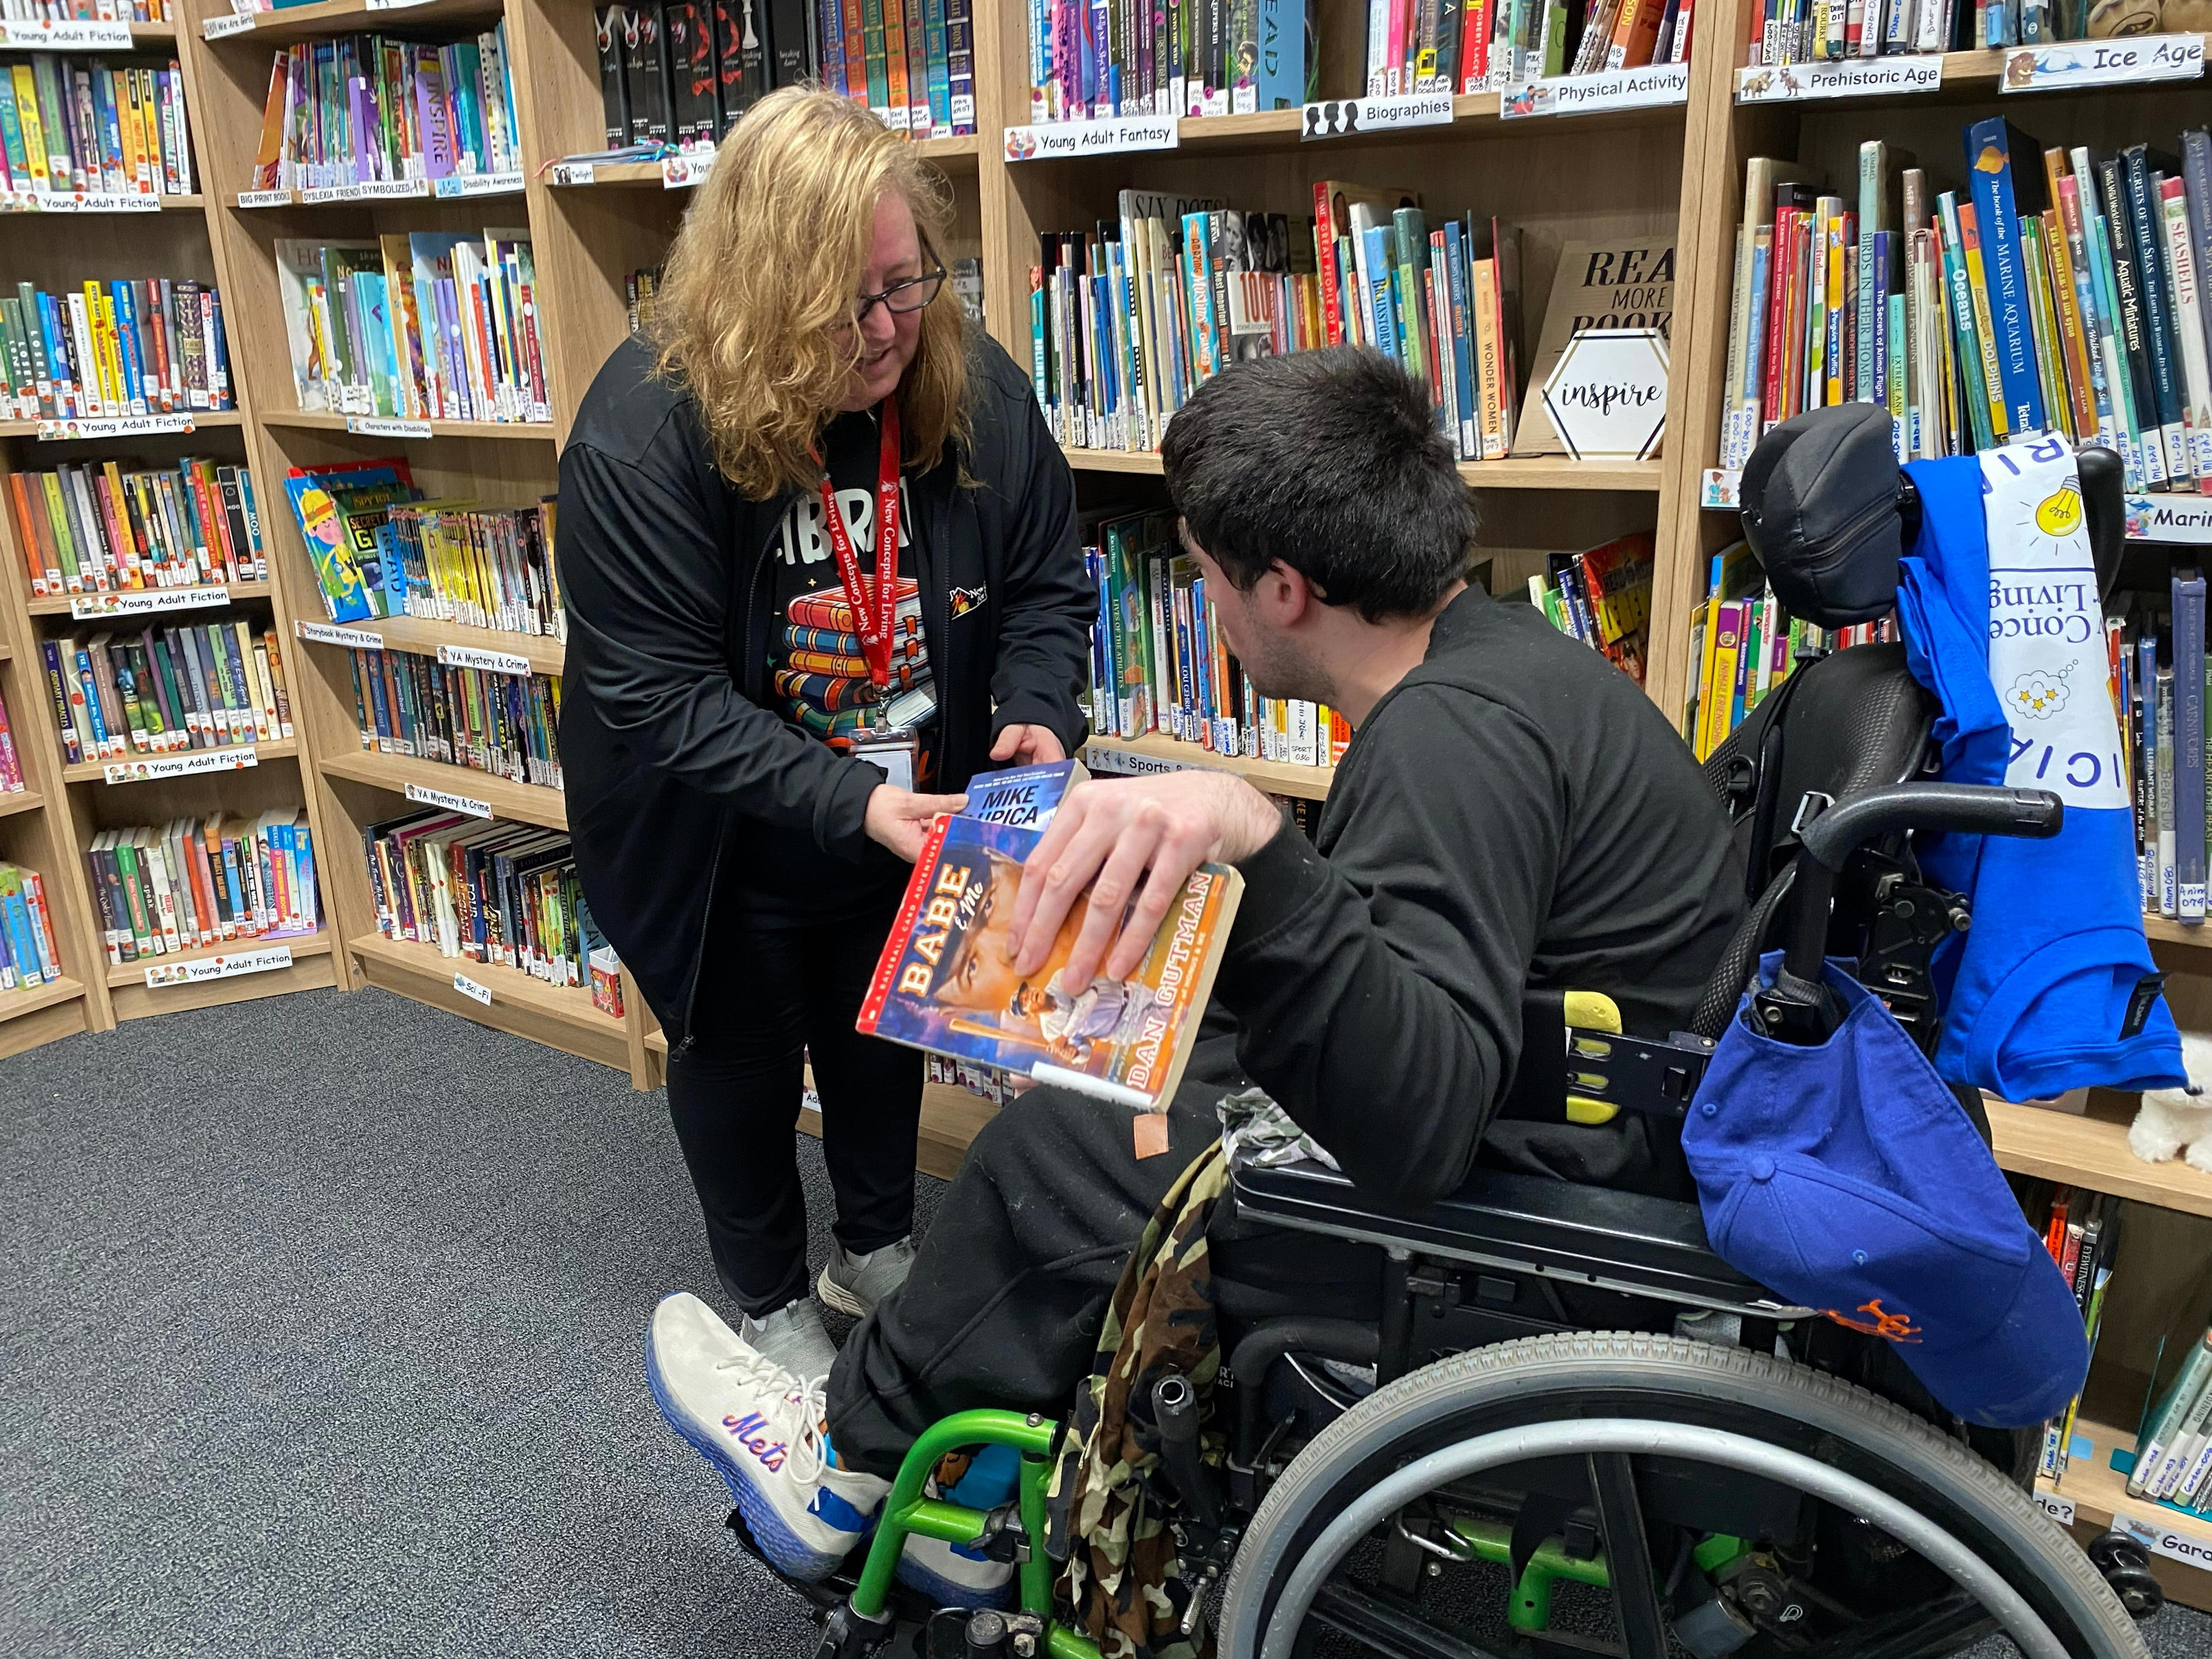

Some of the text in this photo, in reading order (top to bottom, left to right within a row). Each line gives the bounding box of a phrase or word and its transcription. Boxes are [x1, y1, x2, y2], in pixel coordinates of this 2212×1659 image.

[12, 30, 129, 43] Young Adult Fiction
[1673, 17, 1686, 57] HB-012
[1819, 7, 1828, 41] ROURKE
[1472, 7, 1484, 78] ROBERT LACEY
[1610, 47, 1623, 57] HB
[2093, 42, 2202, 69] Ice Age
[1559, 75, 1686, 102] Physical Activity
[1811, 67, 1938, 88] Prehistoric Age
[426, 80, 449, 164] INSPIRE
[1367, 101, 1450, 120] Biographies
[1041, 127, 1170, 149] Young Adult Fantasy
[362, 184, 410, 195] SYMBOLIZED
[463, 176, 523, 190] Disability Awareness
[571, 171, 592, 180] Twilight
[44, 197, 159, 210] Young Adult Fiction
[240, 192, 290, 204] BIG PRINT BOOKS
[303, 190, 334, 202] DYSLEXIA
[2131, 157, 2156, 274] SECRETS OF THE SEAS
[1582, 248, 1675, 287] REA
[1991, 179, 2025, 375] The book of the MARINE AQUARIUM
[2171, 222, 2195, 305] SEASHELLS
[2116, 259, 2135, 297] Aquatic
[1612, 287, 1666, 310] MORE
[1860, 233, 1874, 388] BIRDS IN THEIR HOMES
[1876, 290, 1885, 304] The
[1953, 268, 1973, 331] Oceans
[1372, 277, 1392, 351] BRAINSTORM!
[1572, 313, 1674, 338] BOOK
[1875, 305, 1885, 336] Secrets
[2122, 300, 2142, 351] Miniatures
[30, 330, 46, 379] LOSER
[1875, 336, 1885, 346] of
[1875, 348, 1885, 375] Animal
[1982, 340, 2003, 403] DOLPHINS
[1484, 342, 1498, 434] WONDER WOMEN
[1562, 382, 1663, 416] inspire
[1874, 375, 1885, 397] Flight
[83, 417, 194, 433] Young Adult Fiction
[364, 422, 431, 433] Characters with Disabilities
[248, 511, 260, 536] MOO
[382, 533, 401, 592] READ
[827, 493, 871, 632] New Concepts for Living
[878, 498, 897, 639] New Concepts for Living
[119, 590, 227, 610] Young Adult Fiction
[1989, 580, 2087, 614] Living
[306, 626, 334, 638] Storybook
[335, 630, 358, 643] Mystery
[365, 634, 382, 644] Crime
[1989, 615, 2091, 644] Conce
[450, 650, 528, 671] YA Mystery & Crime
[372, 677, 387, 728] spaced out
[393, 677, 406, 713] poached
[1182, 665, 1192, 713] LOU GEHRIG
[2186, 695, 2199, 768] CARNIVORES
[151, 751, 256, 773] Young Adult Fiction
[1291, 744, 1312, 754] SPORT
[1129, 756, 1170, 774] Sports
[2146, 747, 2156, 818] ELEPHANT WOMAN
[417, 789, 490, 812] YA Mystery & Crime
[981, 785, 1040, 810] MIKE
[968, 806, 1039, 826] UPICA
[143, 884, 154, 909] speak
[164, 894, 174, 913] HEIDI
[454, 869, 471, 940] ALLEGIANT
[466, 883, 478, 918] FOUR
[958, 881, 983, 915] Me
[2179, 884, 2205, 897] Anim
[2182, 896, 2205, 909] 079
[879, 938, 905, 990] BASEBALL
[902, 904, 917, 933] CARD
[913, 838, 940, 899] ADVENTURE
[897, 863, 971, 997] BABE
[191, 953, 290, 976] Young Adult Fiction
[1127, 871, 1213, 1089] DAN GUTMAN
[2075, 1245, 2093, 1294] EYEWITNESS
[722, 1410, 788, 1474] Mets
